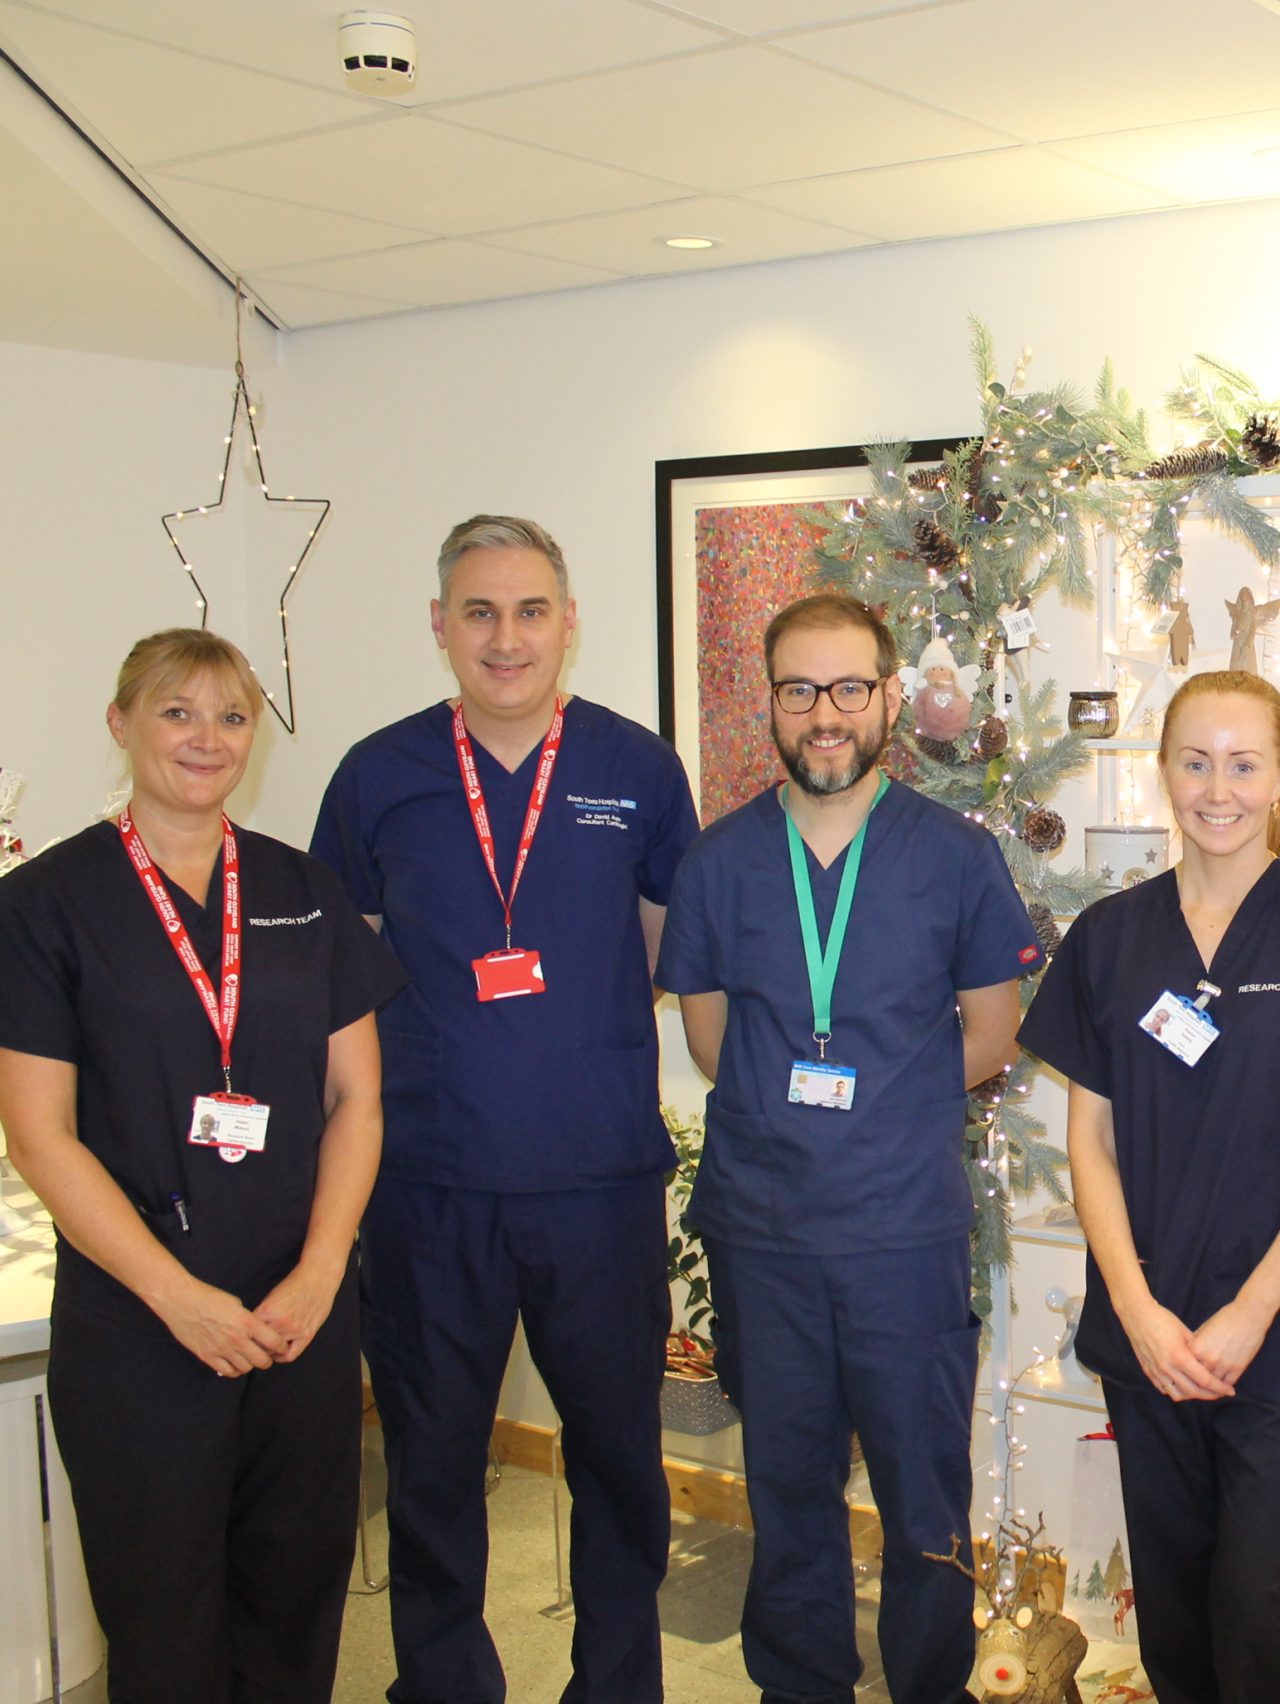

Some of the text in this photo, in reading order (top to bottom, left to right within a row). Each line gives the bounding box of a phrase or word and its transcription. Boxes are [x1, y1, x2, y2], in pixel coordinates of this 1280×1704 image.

[159, 902, 171, 920] SOUTH
[249, 909, 322, 927] RESEARCH TEAM
